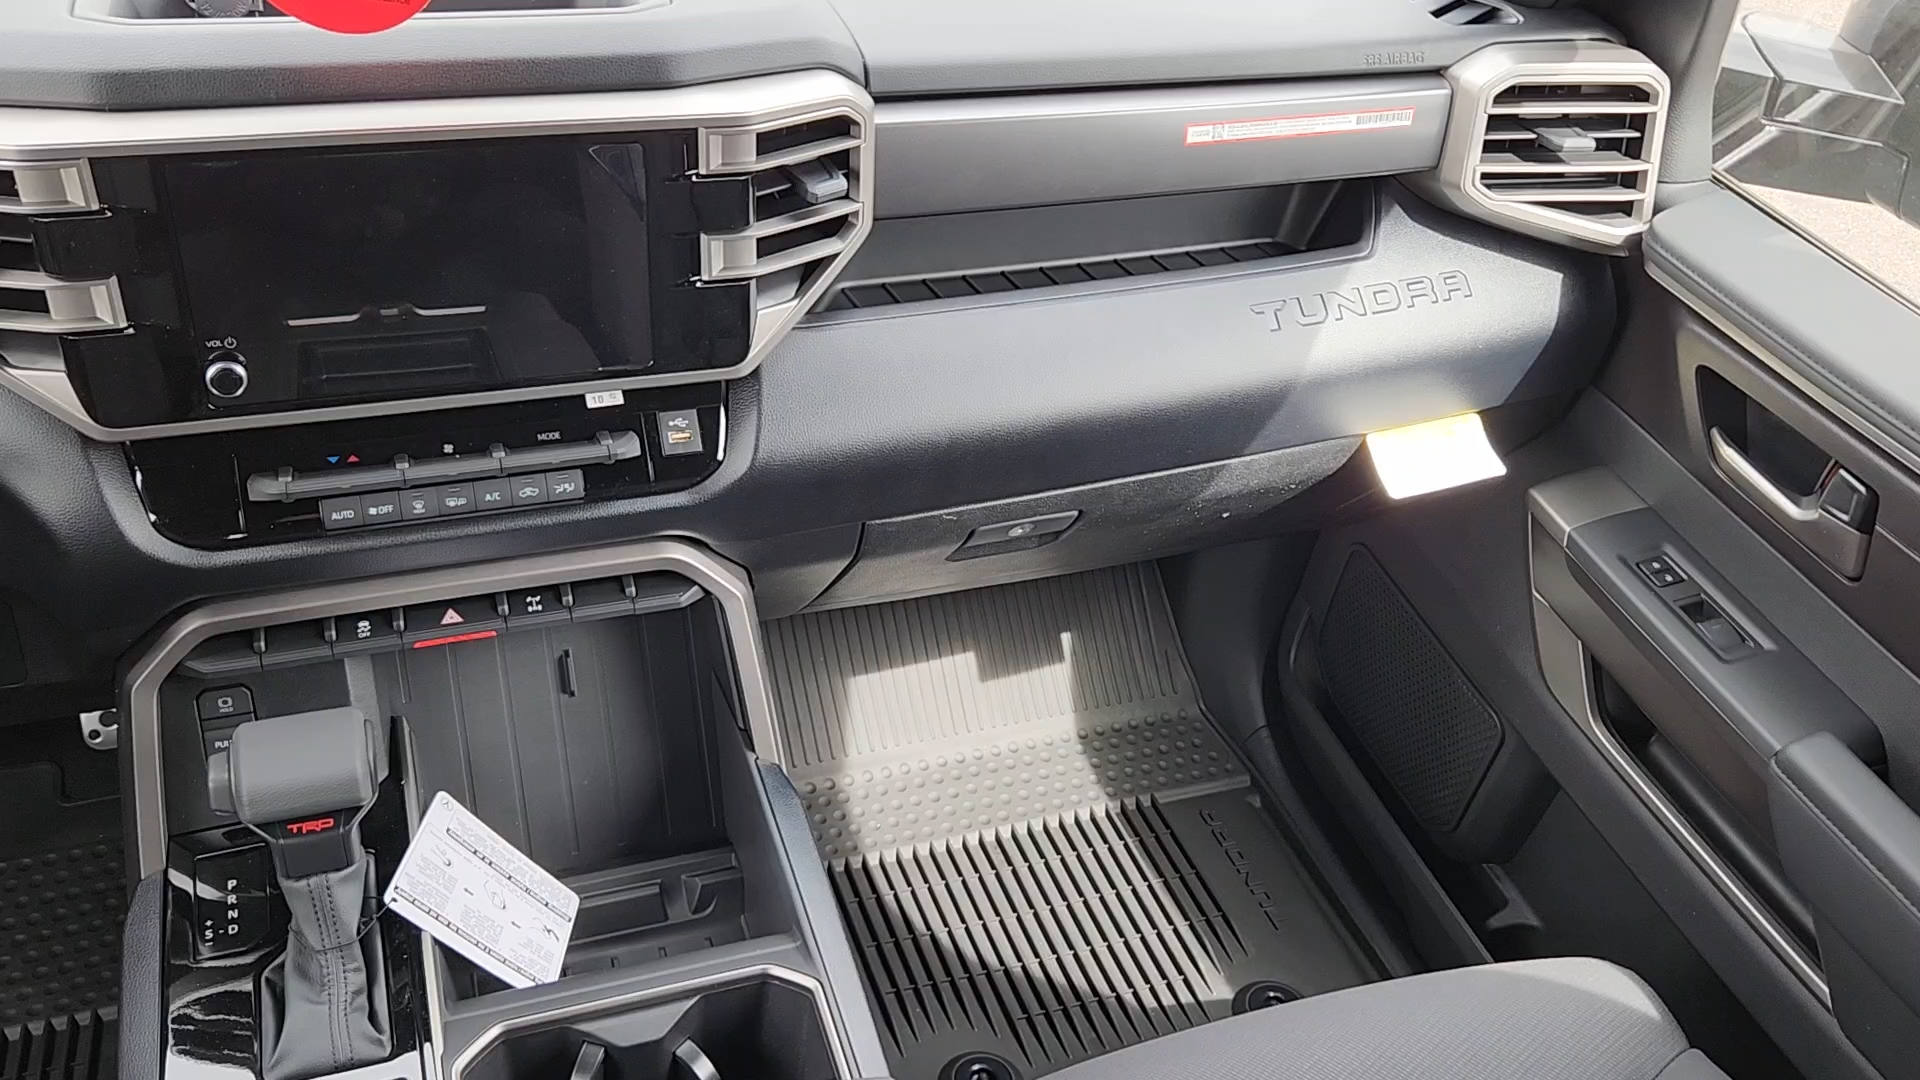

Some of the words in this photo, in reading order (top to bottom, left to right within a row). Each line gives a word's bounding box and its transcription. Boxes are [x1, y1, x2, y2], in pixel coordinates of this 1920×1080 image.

[1362, 54, 1382, 66] SRS
[1384, 51, 1425, 65] AIRBAG
[1249, 269, 1474, 333] TUNDRA
[205, 340, 223, 348] VOL
[592, 395, 605, 405] 10
[537, 431, 562, 442] MODE
[485, 491, 502, 502] A/C
[378, 504, 394, 515] OFF
[331, 510, 355, 521] AUTO
[286, 818, 335, 834] TRD
[1199, 809, 1289, 932] TUNDRA
[227, 879, 238, 891] P
[227, 894, 238, 905] R
[227, 908, 239, 920] N
[204, 929, 214, 940] S
[227, 924, 239, 936] D
